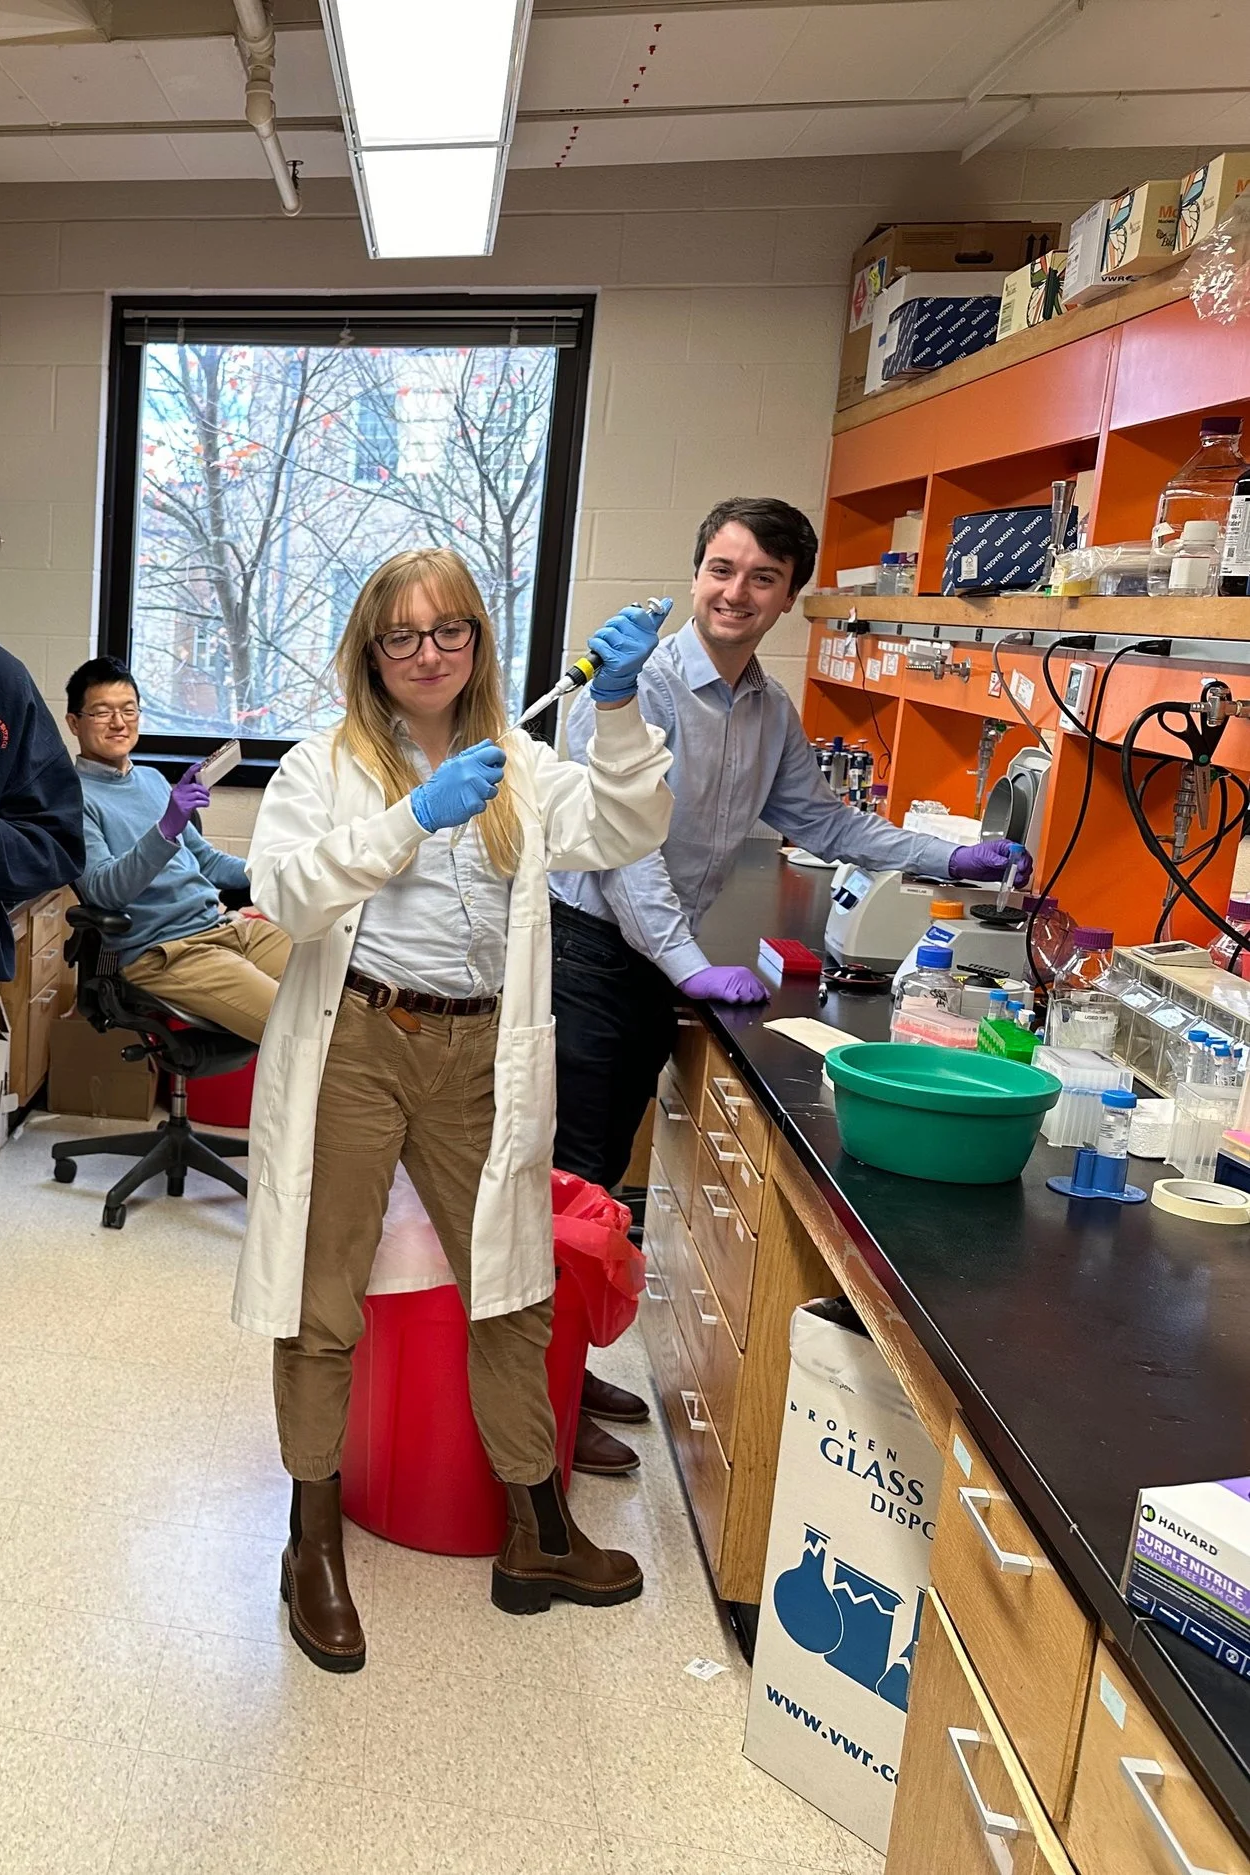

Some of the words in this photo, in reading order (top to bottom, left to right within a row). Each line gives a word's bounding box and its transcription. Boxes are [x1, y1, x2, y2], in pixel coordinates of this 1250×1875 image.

[971, 309, 990, 326] QIAGEN
[924, 325, 943, 342] QIAGEN
[936, 338, 955, 355] QIAGEN
[978, 514, 999, 534] QIAGEN
[1021, 515, 1043, 536] QIAGEN
[994, 527, 1016, 547] QIAGEN
[1011, 540, 1032, 560] QIAGEN
[983, 552, 1004, 572] QIAGEN
[1000, 565, 1021, 585] QIAGEN
[790, 1401, 898, 1462] BROKEN
[819, 1437, 924, 1506] GLASS
[1158, 1515, 1218, 1556] HALYARD
[1136, 1542, 1199, 1585] POWDER-FREE
[1198, 1578, 1224, 1599] EXAM
[1137, 1528, 1188, 1567] PURPLE
[1189, 1554, 1247, 1601] NITRILE
